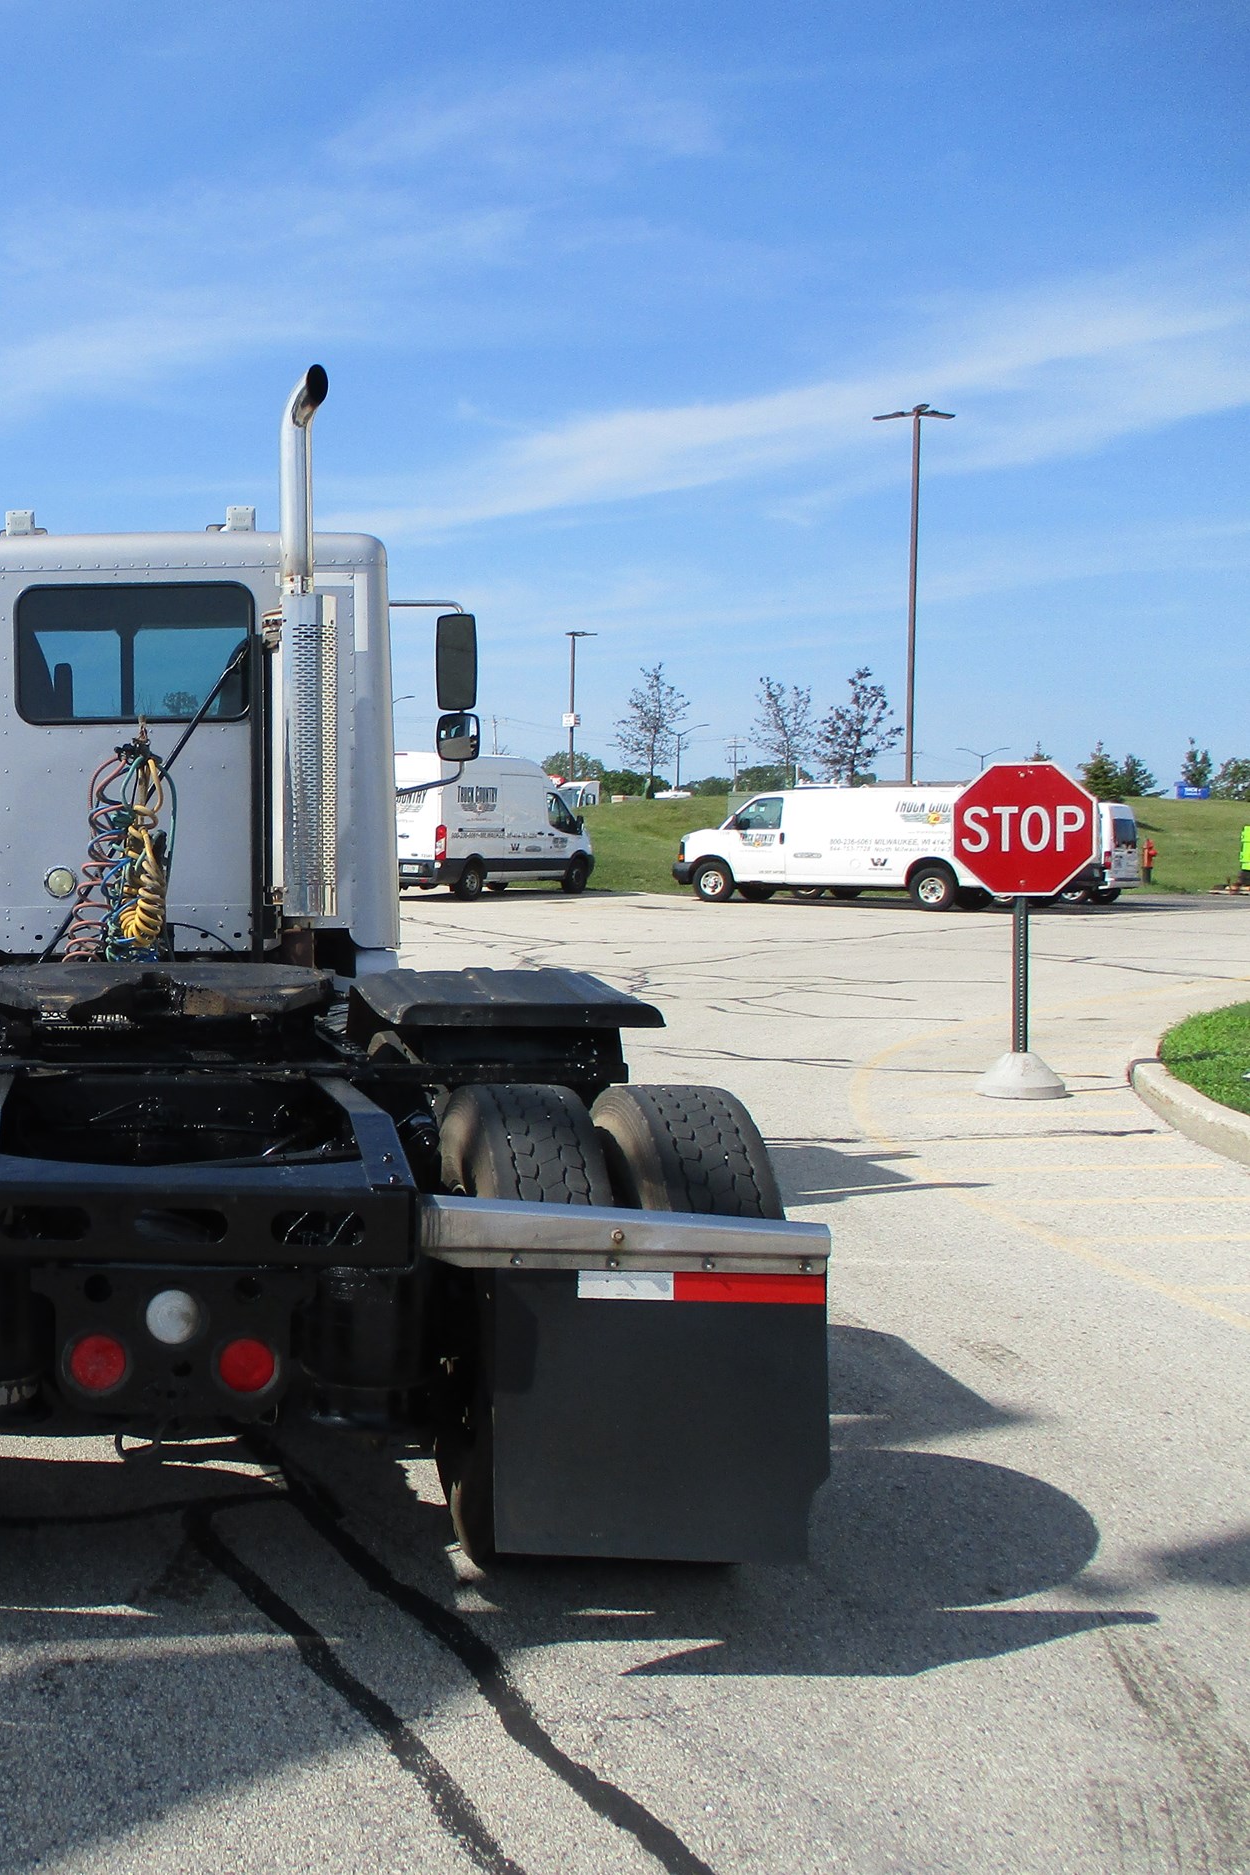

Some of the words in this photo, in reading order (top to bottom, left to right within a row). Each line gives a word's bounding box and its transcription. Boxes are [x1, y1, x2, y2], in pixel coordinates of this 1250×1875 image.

[396, 788, 427, 804] OUNTRY
[457, 785, 474, 803] TRUCK
[475, 785, 498, 803] COUNTRY
[961, 805, 1086, 853] STOP
